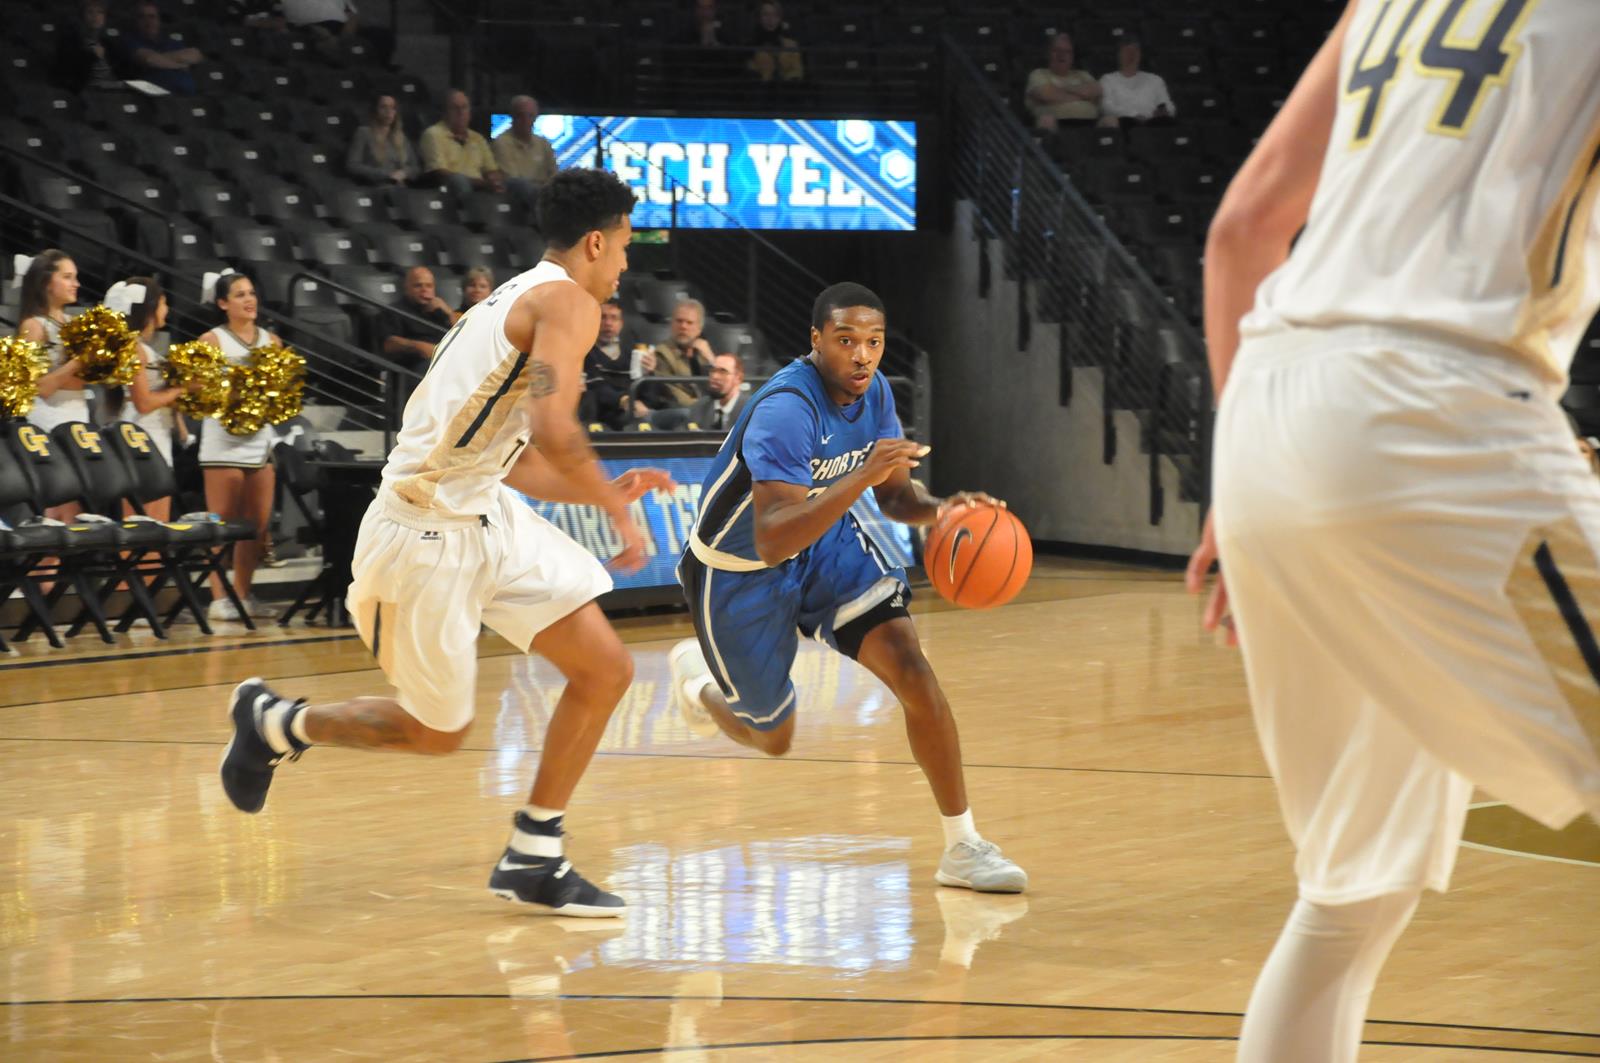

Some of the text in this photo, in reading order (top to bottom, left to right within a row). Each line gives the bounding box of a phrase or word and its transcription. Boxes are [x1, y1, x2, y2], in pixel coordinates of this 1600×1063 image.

[1345, 0, 1536, 150] 44
[577, 141, 882, 206] ECH YEL
